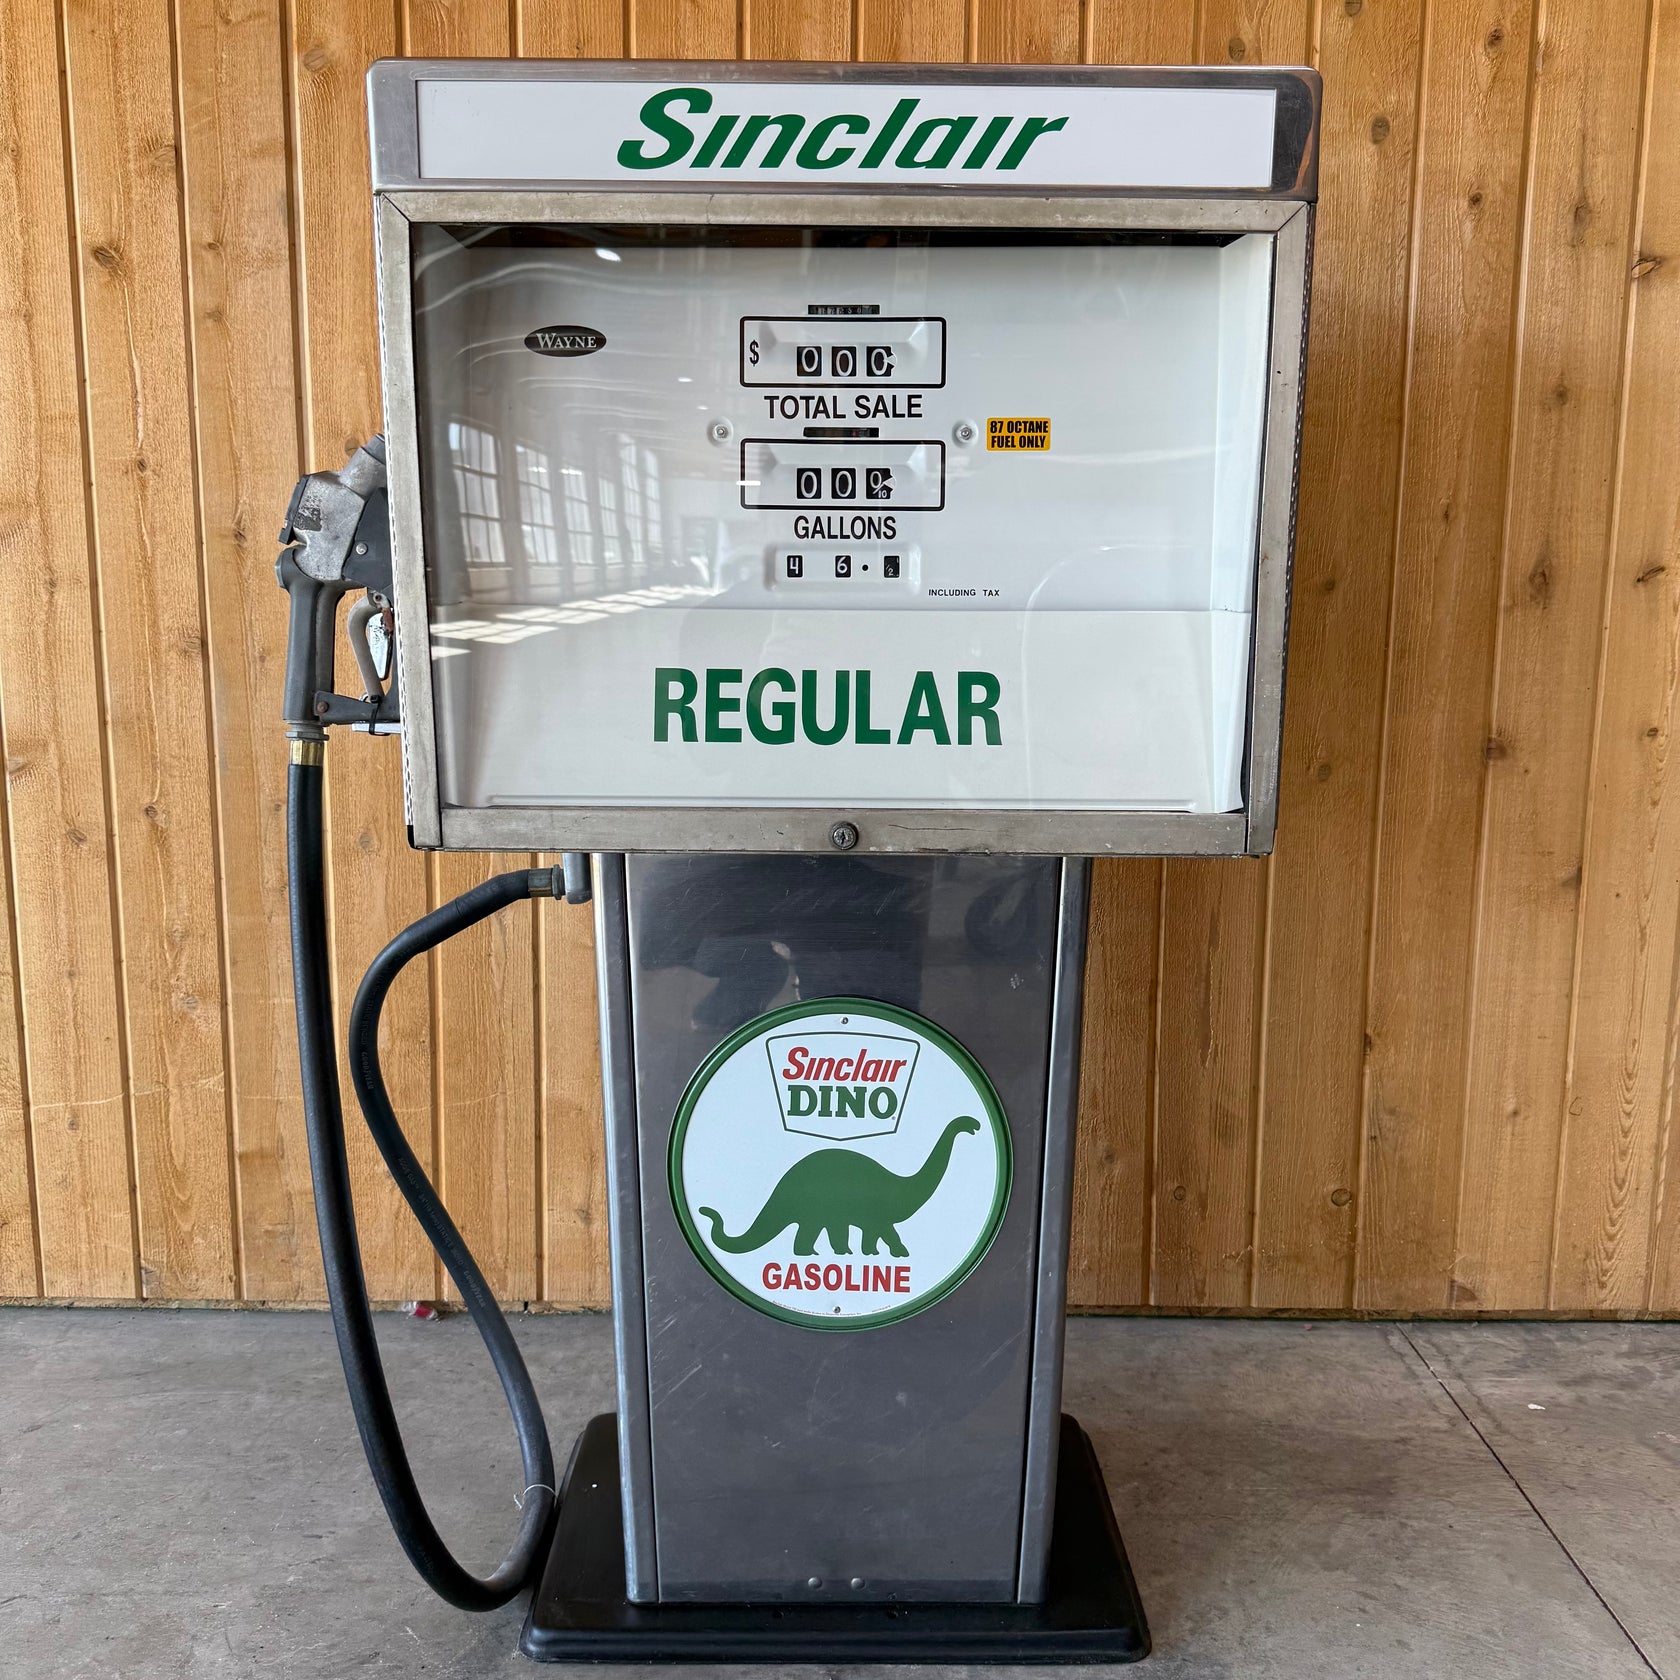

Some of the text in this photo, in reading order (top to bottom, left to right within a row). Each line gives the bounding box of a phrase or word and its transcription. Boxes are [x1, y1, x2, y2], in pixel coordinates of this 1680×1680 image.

[617, 87, 1070, 170] Sinclair
[749, 339, 760, 367] $
[764, 394, 923, 419] TOTAL SALE
[990, 420, 1049, 433] 87 OCTANE
[991, 435, 1046, 448] FUEL ONLY
[794, 516, 897, 539] GALLONS
[789, 557, 799, 575] 4
[928, 588, 1000, 597] INCLUDING TAX
[653, 667, 1003, 746] REGULAR
[782, 1046, 908, 1083] Sinclair
[787, 1084, 898, 1120] DINO
[762, 1262, 911, 1293] GASOLINE
